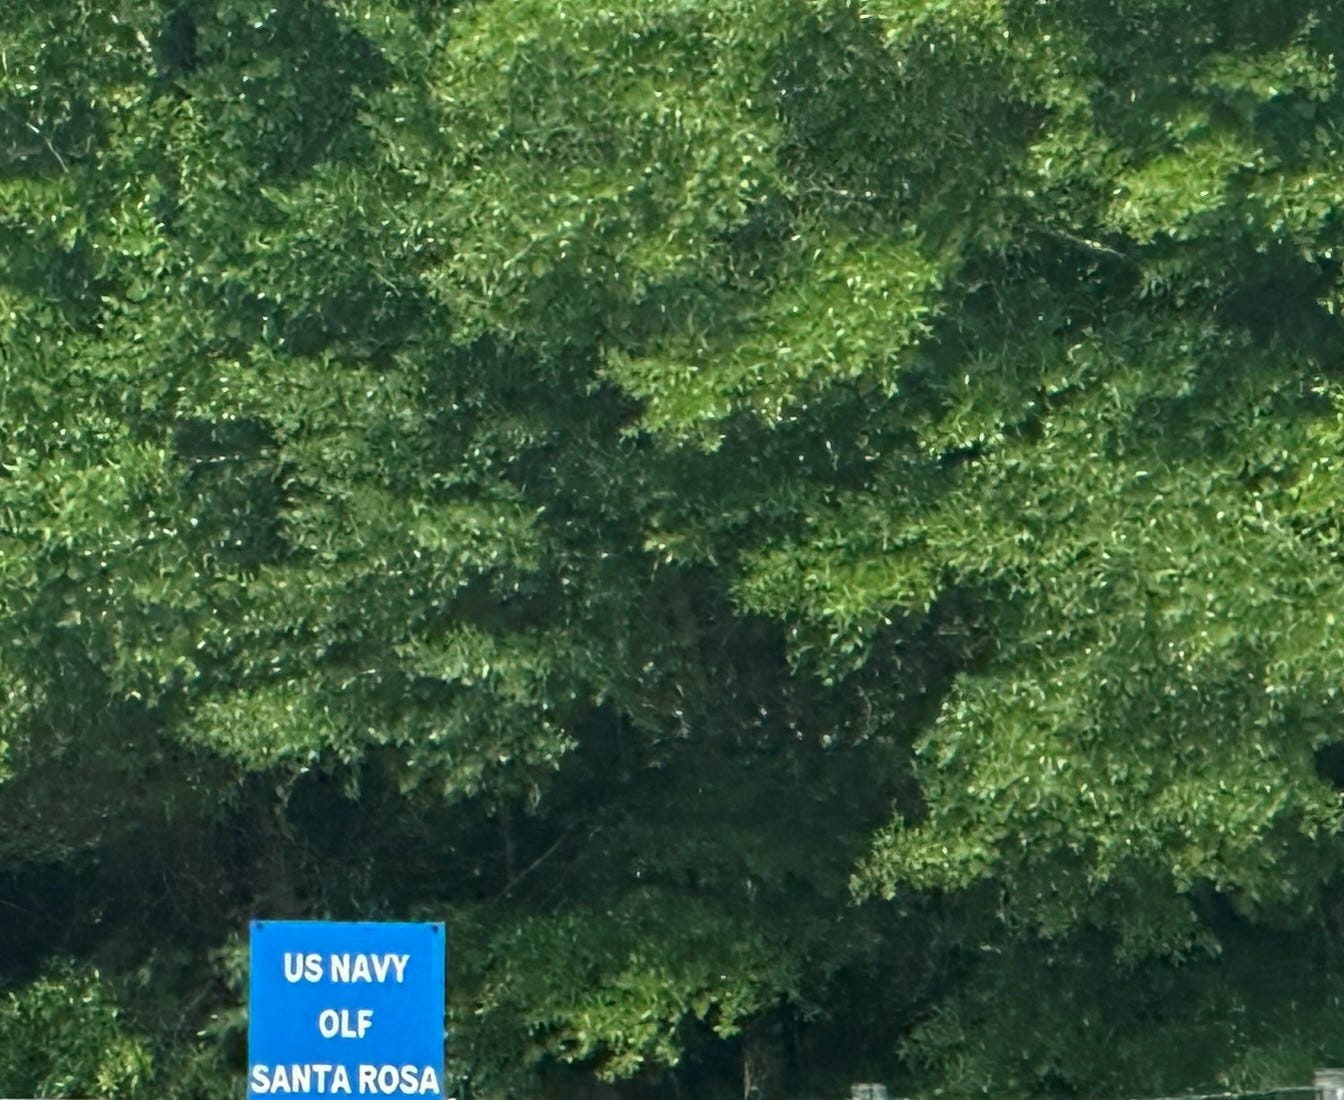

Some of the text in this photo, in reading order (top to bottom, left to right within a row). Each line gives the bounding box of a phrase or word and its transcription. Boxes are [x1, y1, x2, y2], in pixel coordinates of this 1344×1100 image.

[283, 952, 410, 983] US NAVY
[319, 1009, 374, 1039] OLF
[250, 1064, 440, 1095] SANTA ROSA
